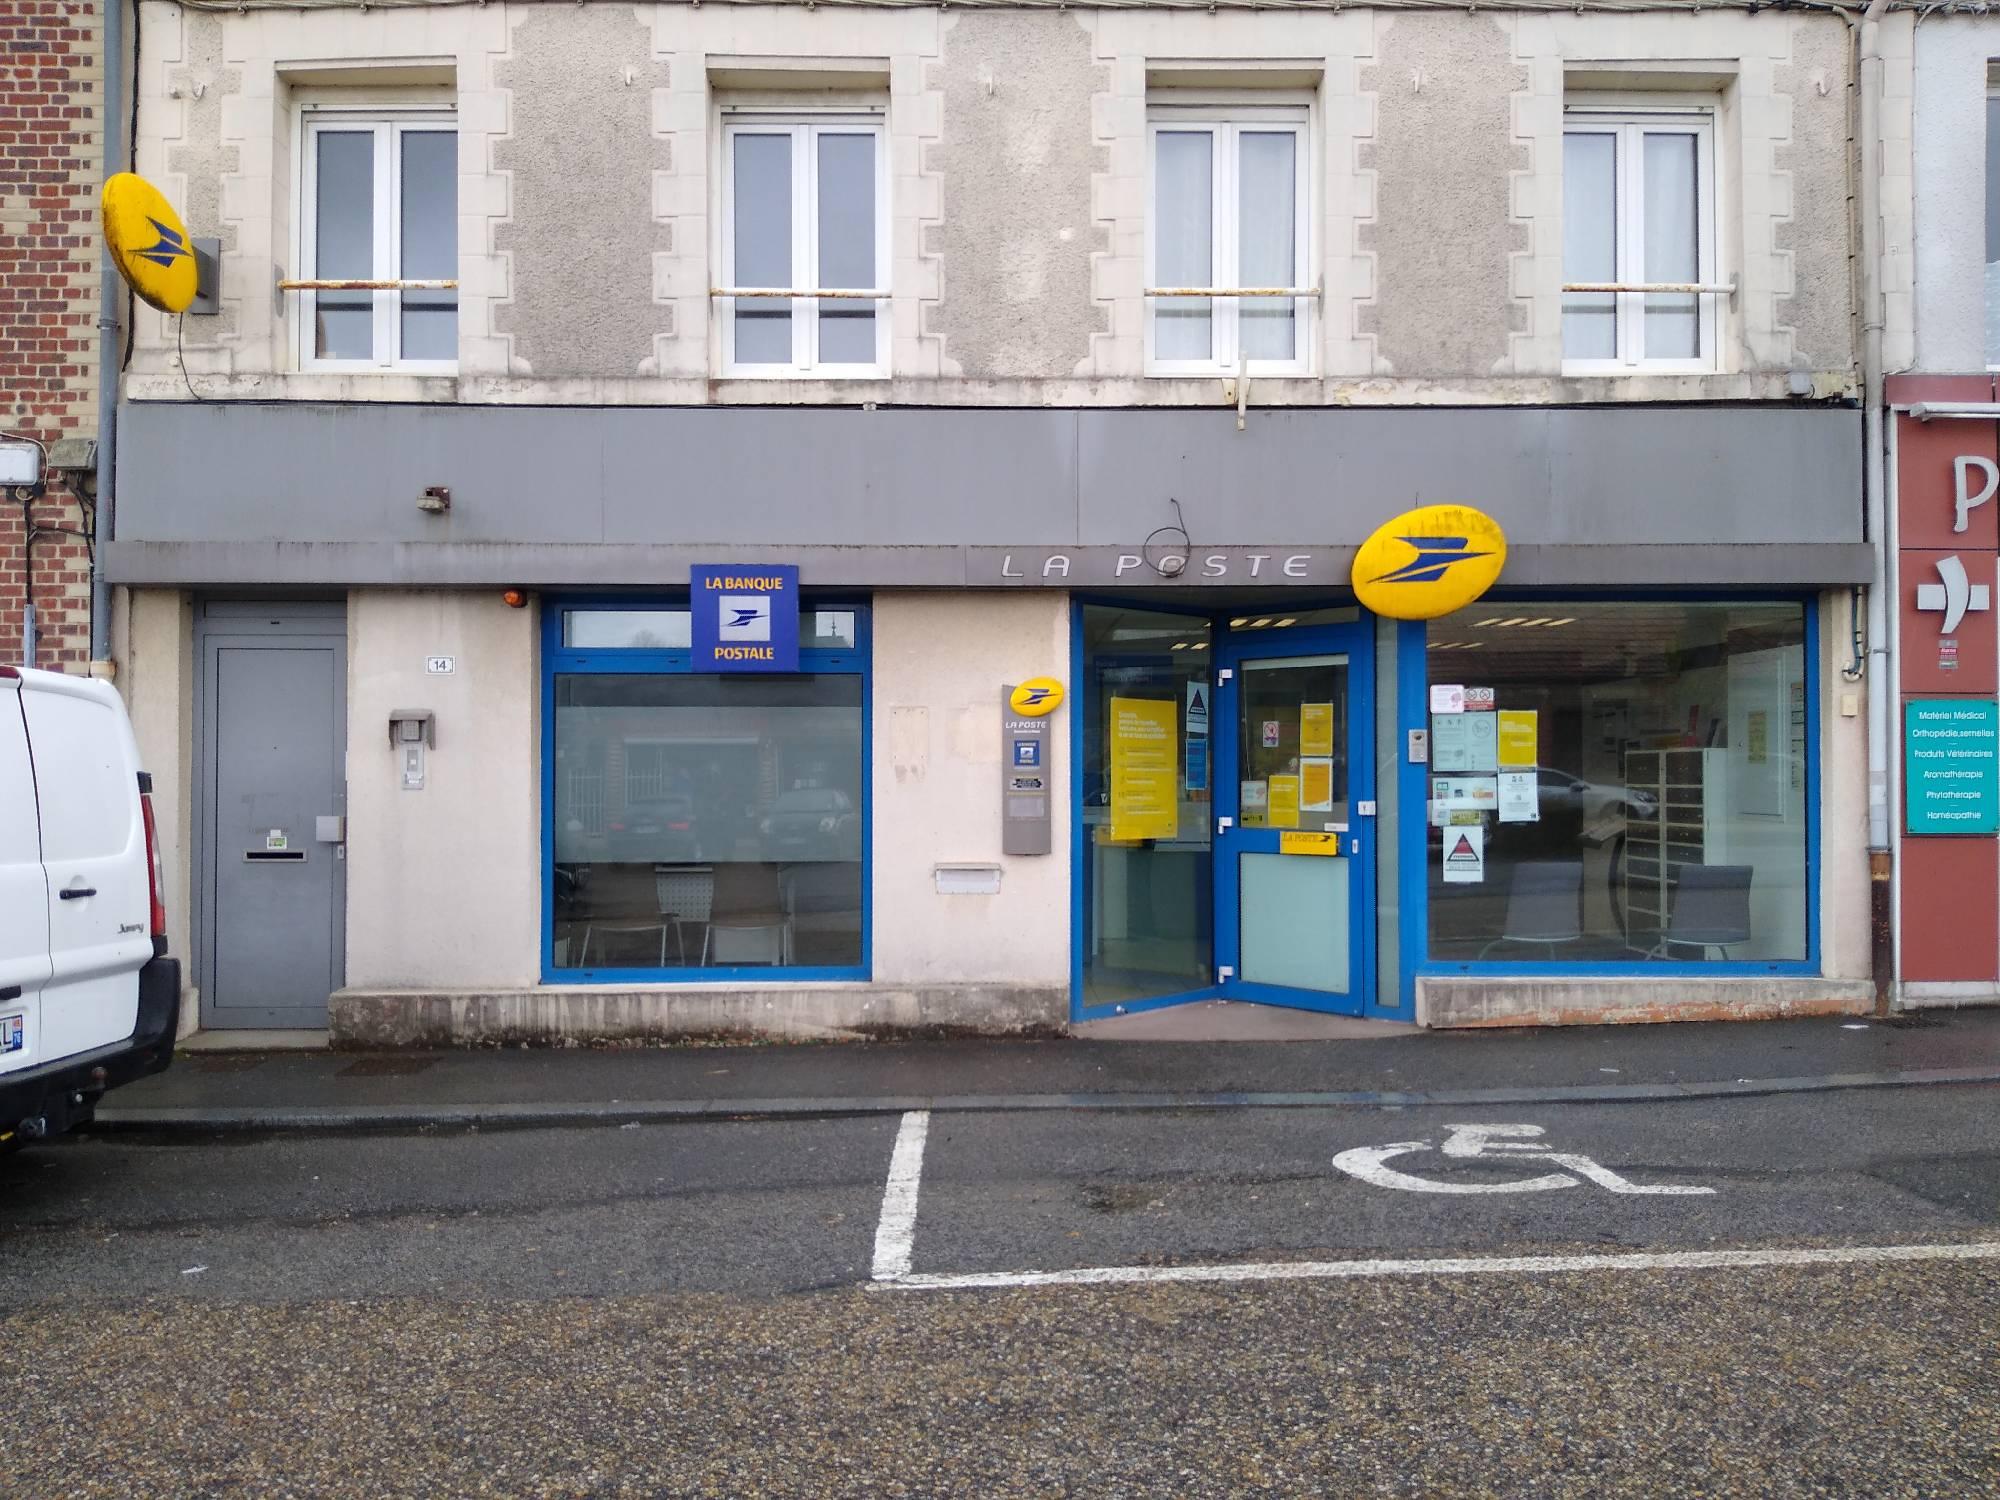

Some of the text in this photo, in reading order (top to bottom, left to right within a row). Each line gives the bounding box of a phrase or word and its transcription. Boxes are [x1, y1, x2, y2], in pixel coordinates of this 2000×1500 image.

[1954, 455, 1999, 533] P
[1001, 554, 1313, 578] LA POSTE
[705, 577, 784, 591] LA BANQUE
[714, 647, 775, 660] POSTALE
[434, 660, 447, 671] 14
[1919, 711, 1987, 720] Matériel Médical
[1005, 721, 1046, 729] LA POSTE
[1914, 750, 1993, 758] Produits Vétérinaires
[1923, 771, 1983, 779] Aromathérapie
[1927, 811, 1982, 820] Homéopathie
